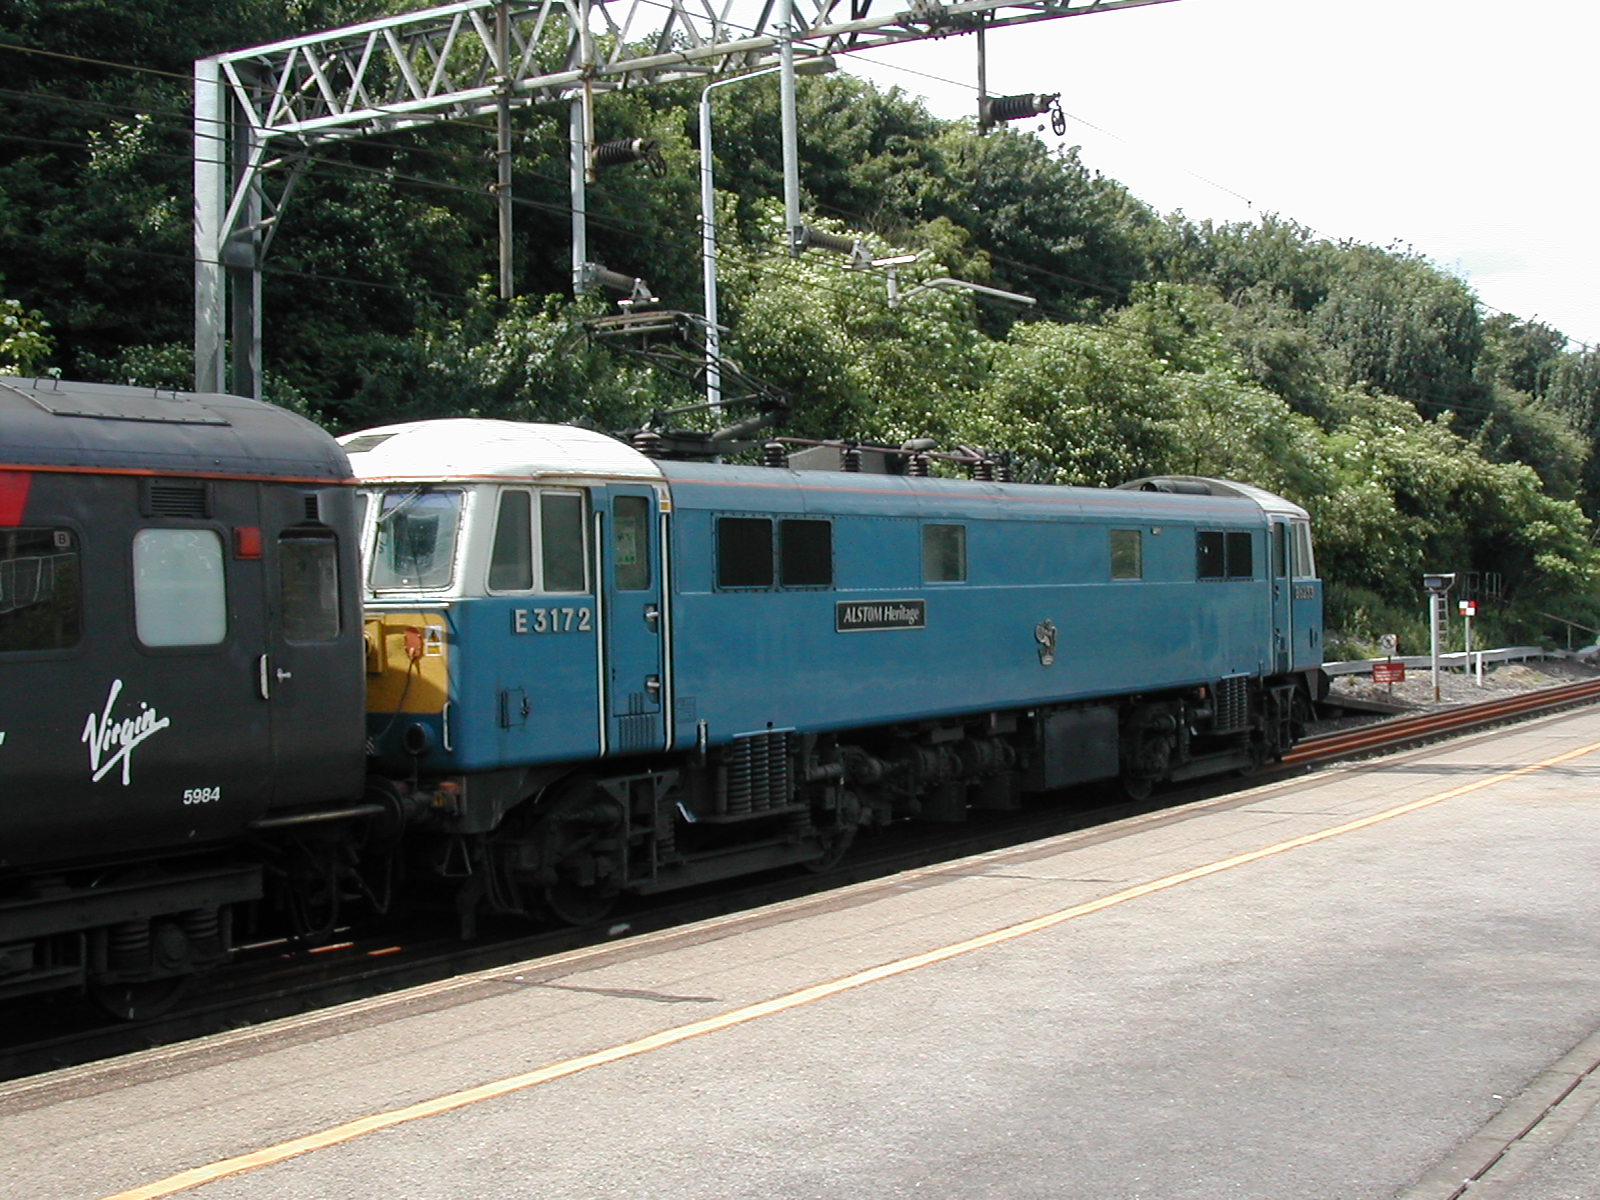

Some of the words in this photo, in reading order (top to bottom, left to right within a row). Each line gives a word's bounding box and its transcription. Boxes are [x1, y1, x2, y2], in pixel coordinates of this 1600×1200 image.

[58, 533, 66, 545] B
[515, 609, 528, 633] E
[534, 608, 592, 633] 3172
[844, 606, 882, 623] ALSTOM
[883, 604, 920, 624] Heritage
[82, 679, 170, 786] Virgin
[183, 787, 221, 805] 5984
